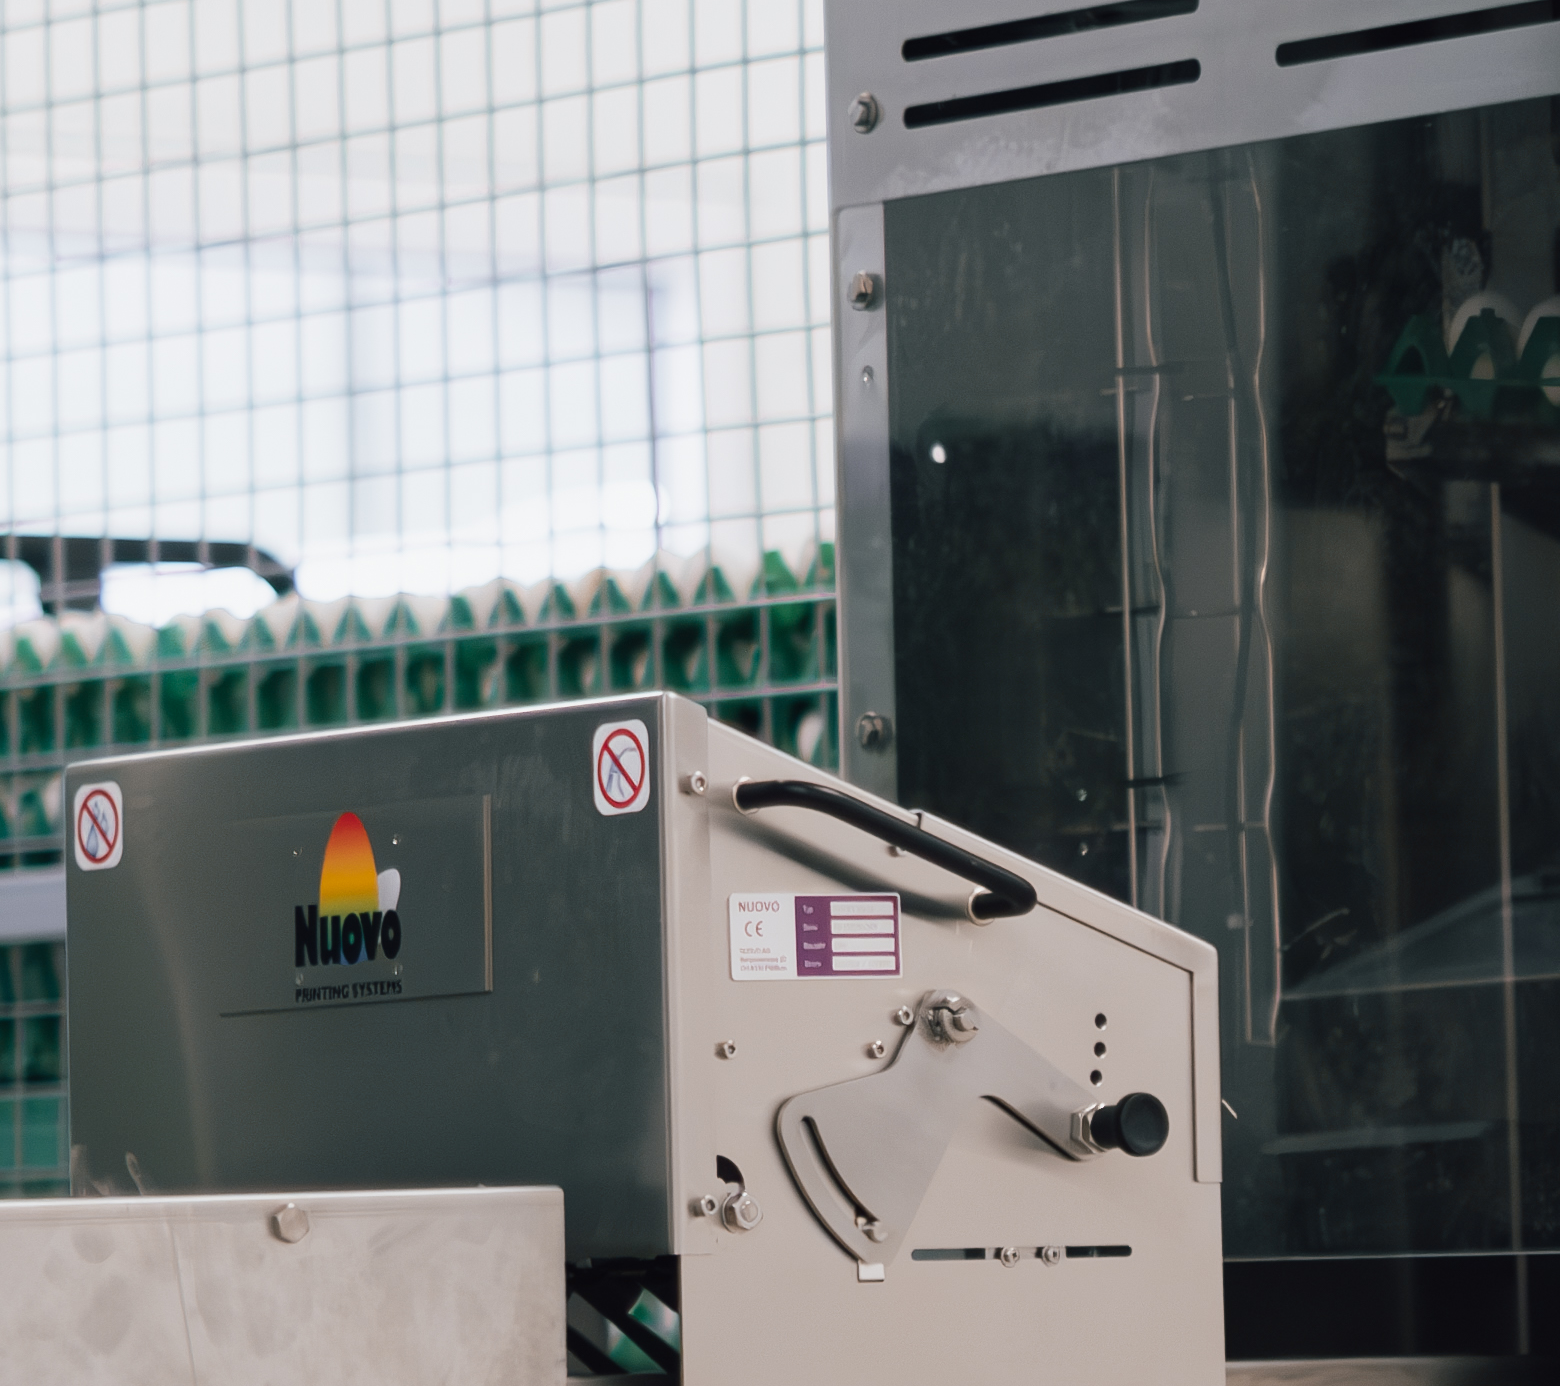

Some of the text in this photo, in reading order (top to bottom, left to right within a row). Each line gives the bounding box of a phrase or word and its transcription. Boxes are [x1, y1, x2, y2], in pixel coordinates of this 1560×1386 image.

[738, 900, 780, 913] NUOVO
[295, 904, 402, 968] Nuovo
[295, 979, 403, 1003] PRINTING SYSTEMS
